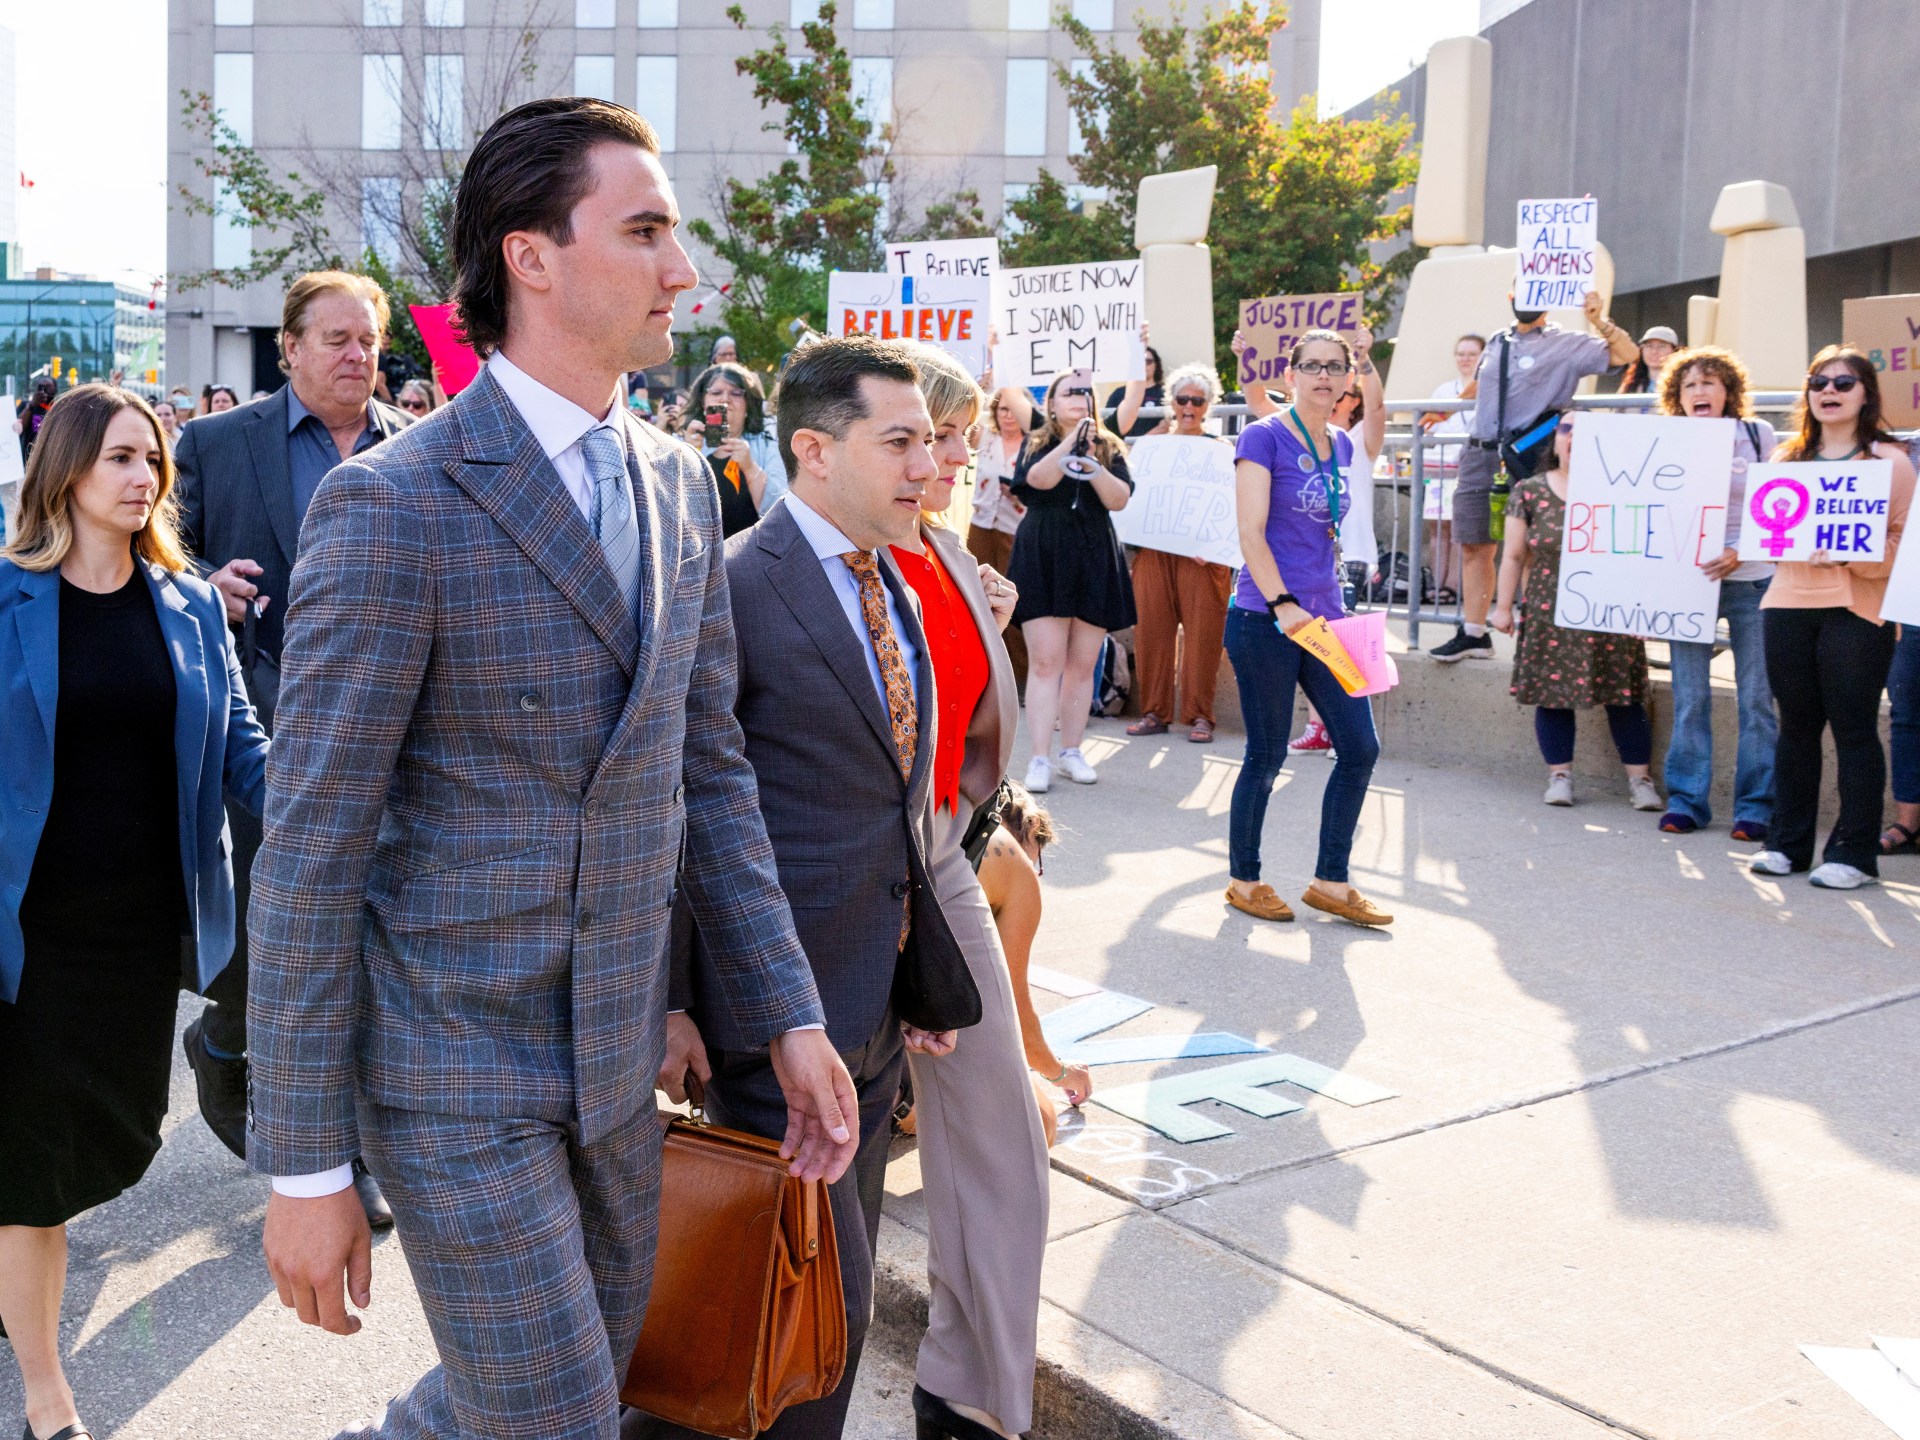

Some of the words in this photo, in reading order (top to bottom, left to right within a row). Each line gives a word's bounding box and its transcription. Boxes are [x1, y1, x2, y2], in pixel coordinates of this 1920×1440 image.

[1521, 202, 1595, 225] RESPECT
[1533, 227, 1581, 250] ALL
[926, 253, 990, 276] BELIEVE
[901, 276, 913, 304] I
[1009, 271, 1072, 297] JUSTICE
[1081, 264, 1139, 291] NOW
[1525, 280, 1588, 307] TRUTHS
[843, 308, 973, 342] BELIEVE
[1006, 308, 1018, 336] I
[1028, 304, 1085, 333] STAND
[1095, 302, 1137, 331] WITH
[1245, 298, 1357, 331] JUSTICE
[1169, 443, 1236, 488] Believ
[1595, 434, 1686, 492] We
[1819, 476, 1858, 493] WE
[1815, 498, 1888, 515] BELIEVE
[1567, 502, 1725, 567] BELIEVE
[1815, 522, 1873, 553] HER
[1560, 570, 1706, 639] Survivors
[1303, 635, 1331, 657] CHANTS
